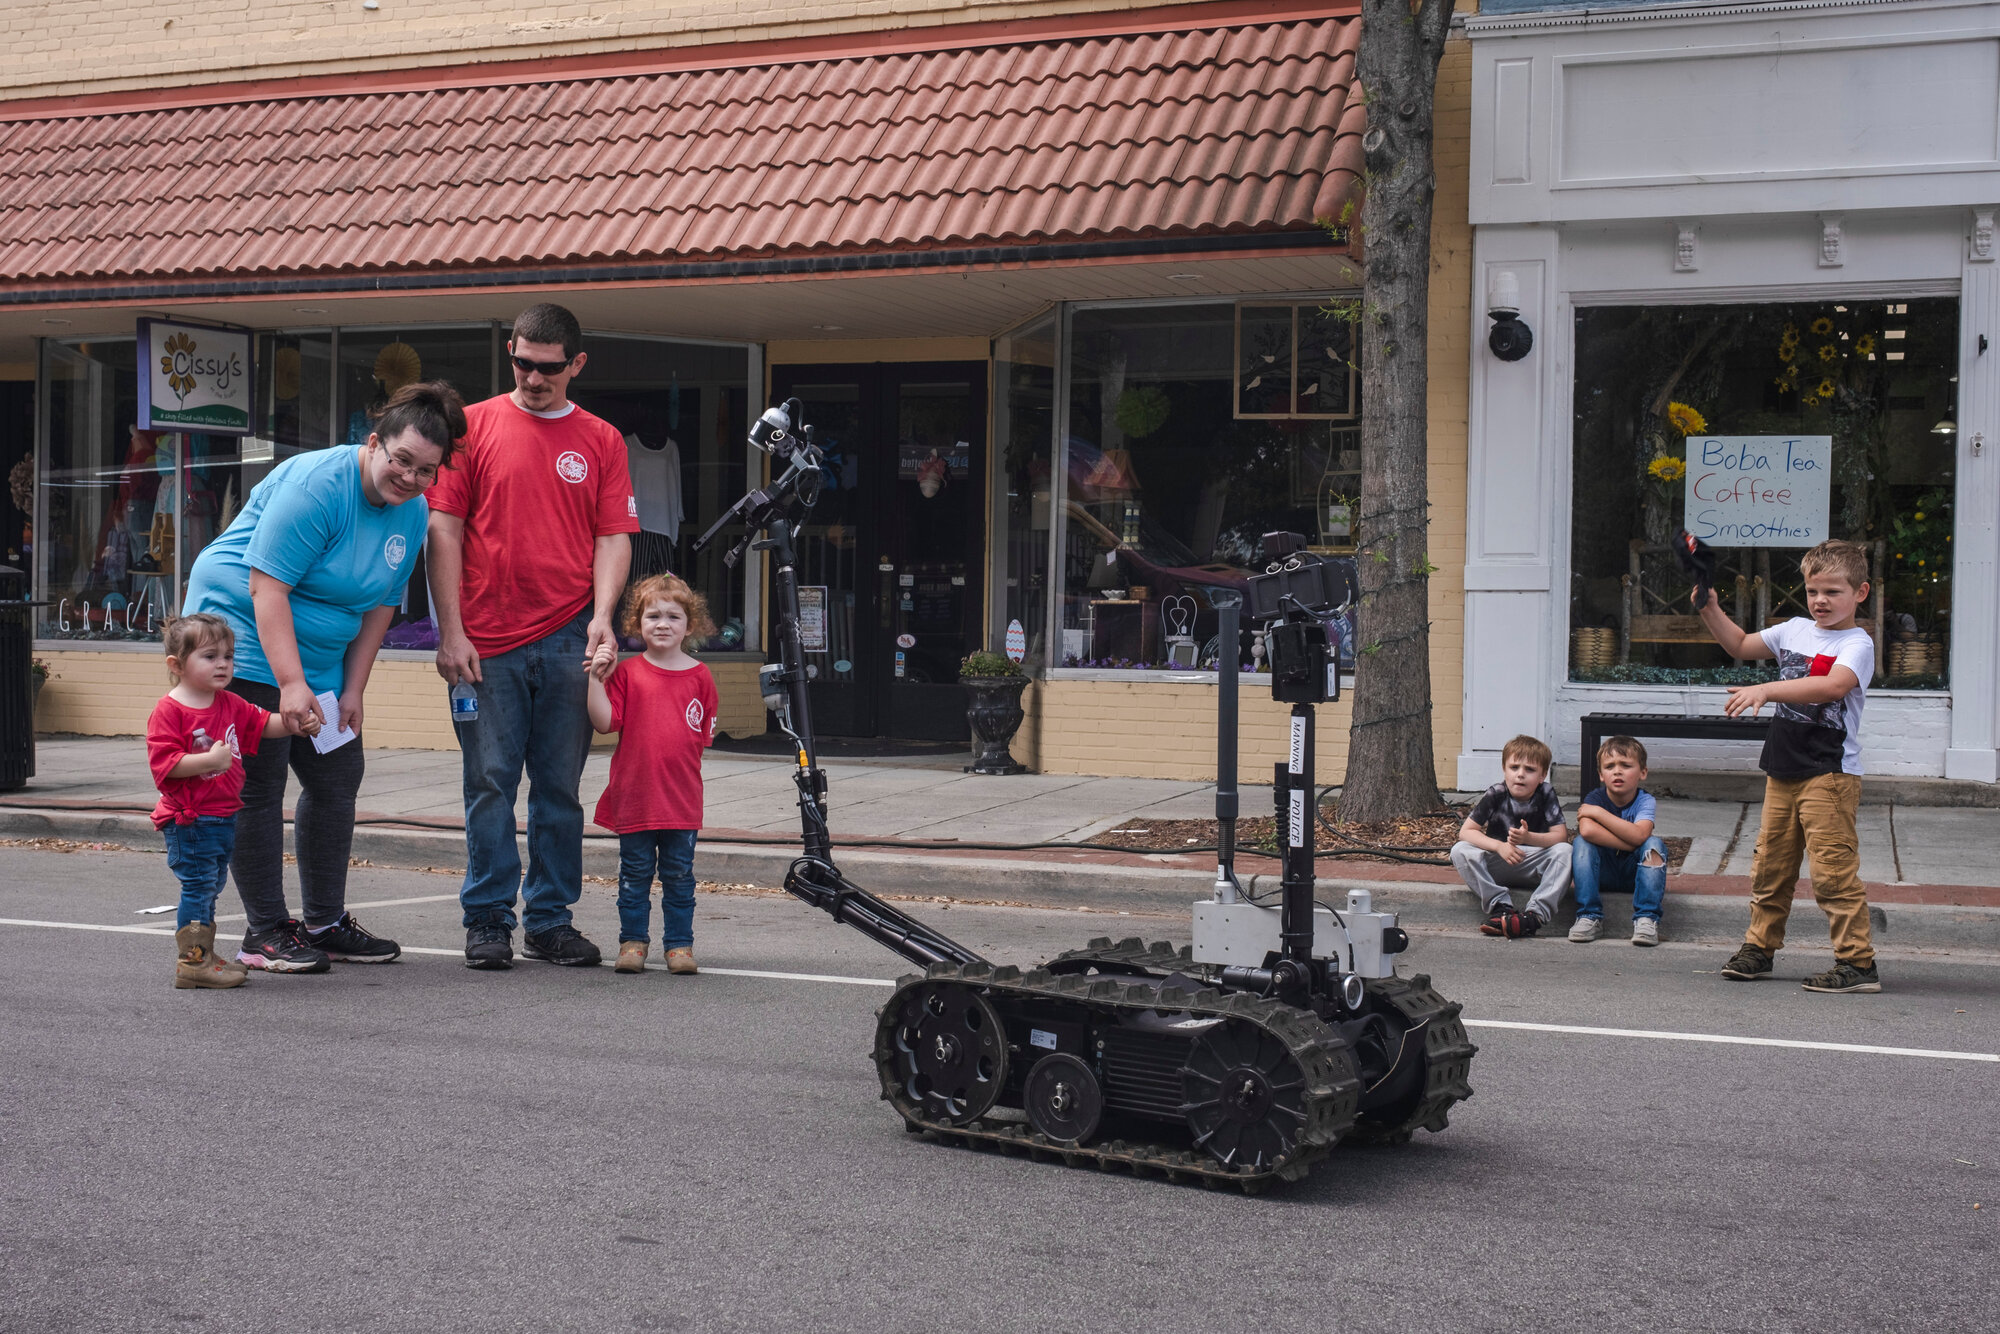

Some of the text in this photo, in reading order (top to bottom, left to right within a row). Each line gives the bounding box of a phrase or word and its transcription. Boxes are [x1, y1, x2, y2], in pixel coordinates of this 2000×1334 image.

[175, 351, 242, 389] Cissy's
[165, 413, 176, 421] shop
[178, 413, 192, 421] filled
[1702, 440, 1822, 473] Boba Tea
[1694, 472, 1792, 506] Coffee
[1696, 509, 1812, 539] Smoothies
[60, 598, 154, 632] GRACE
[1291, 721, 1301, 772] MANNING
[1291, 798, 1301, 843] POLICE
